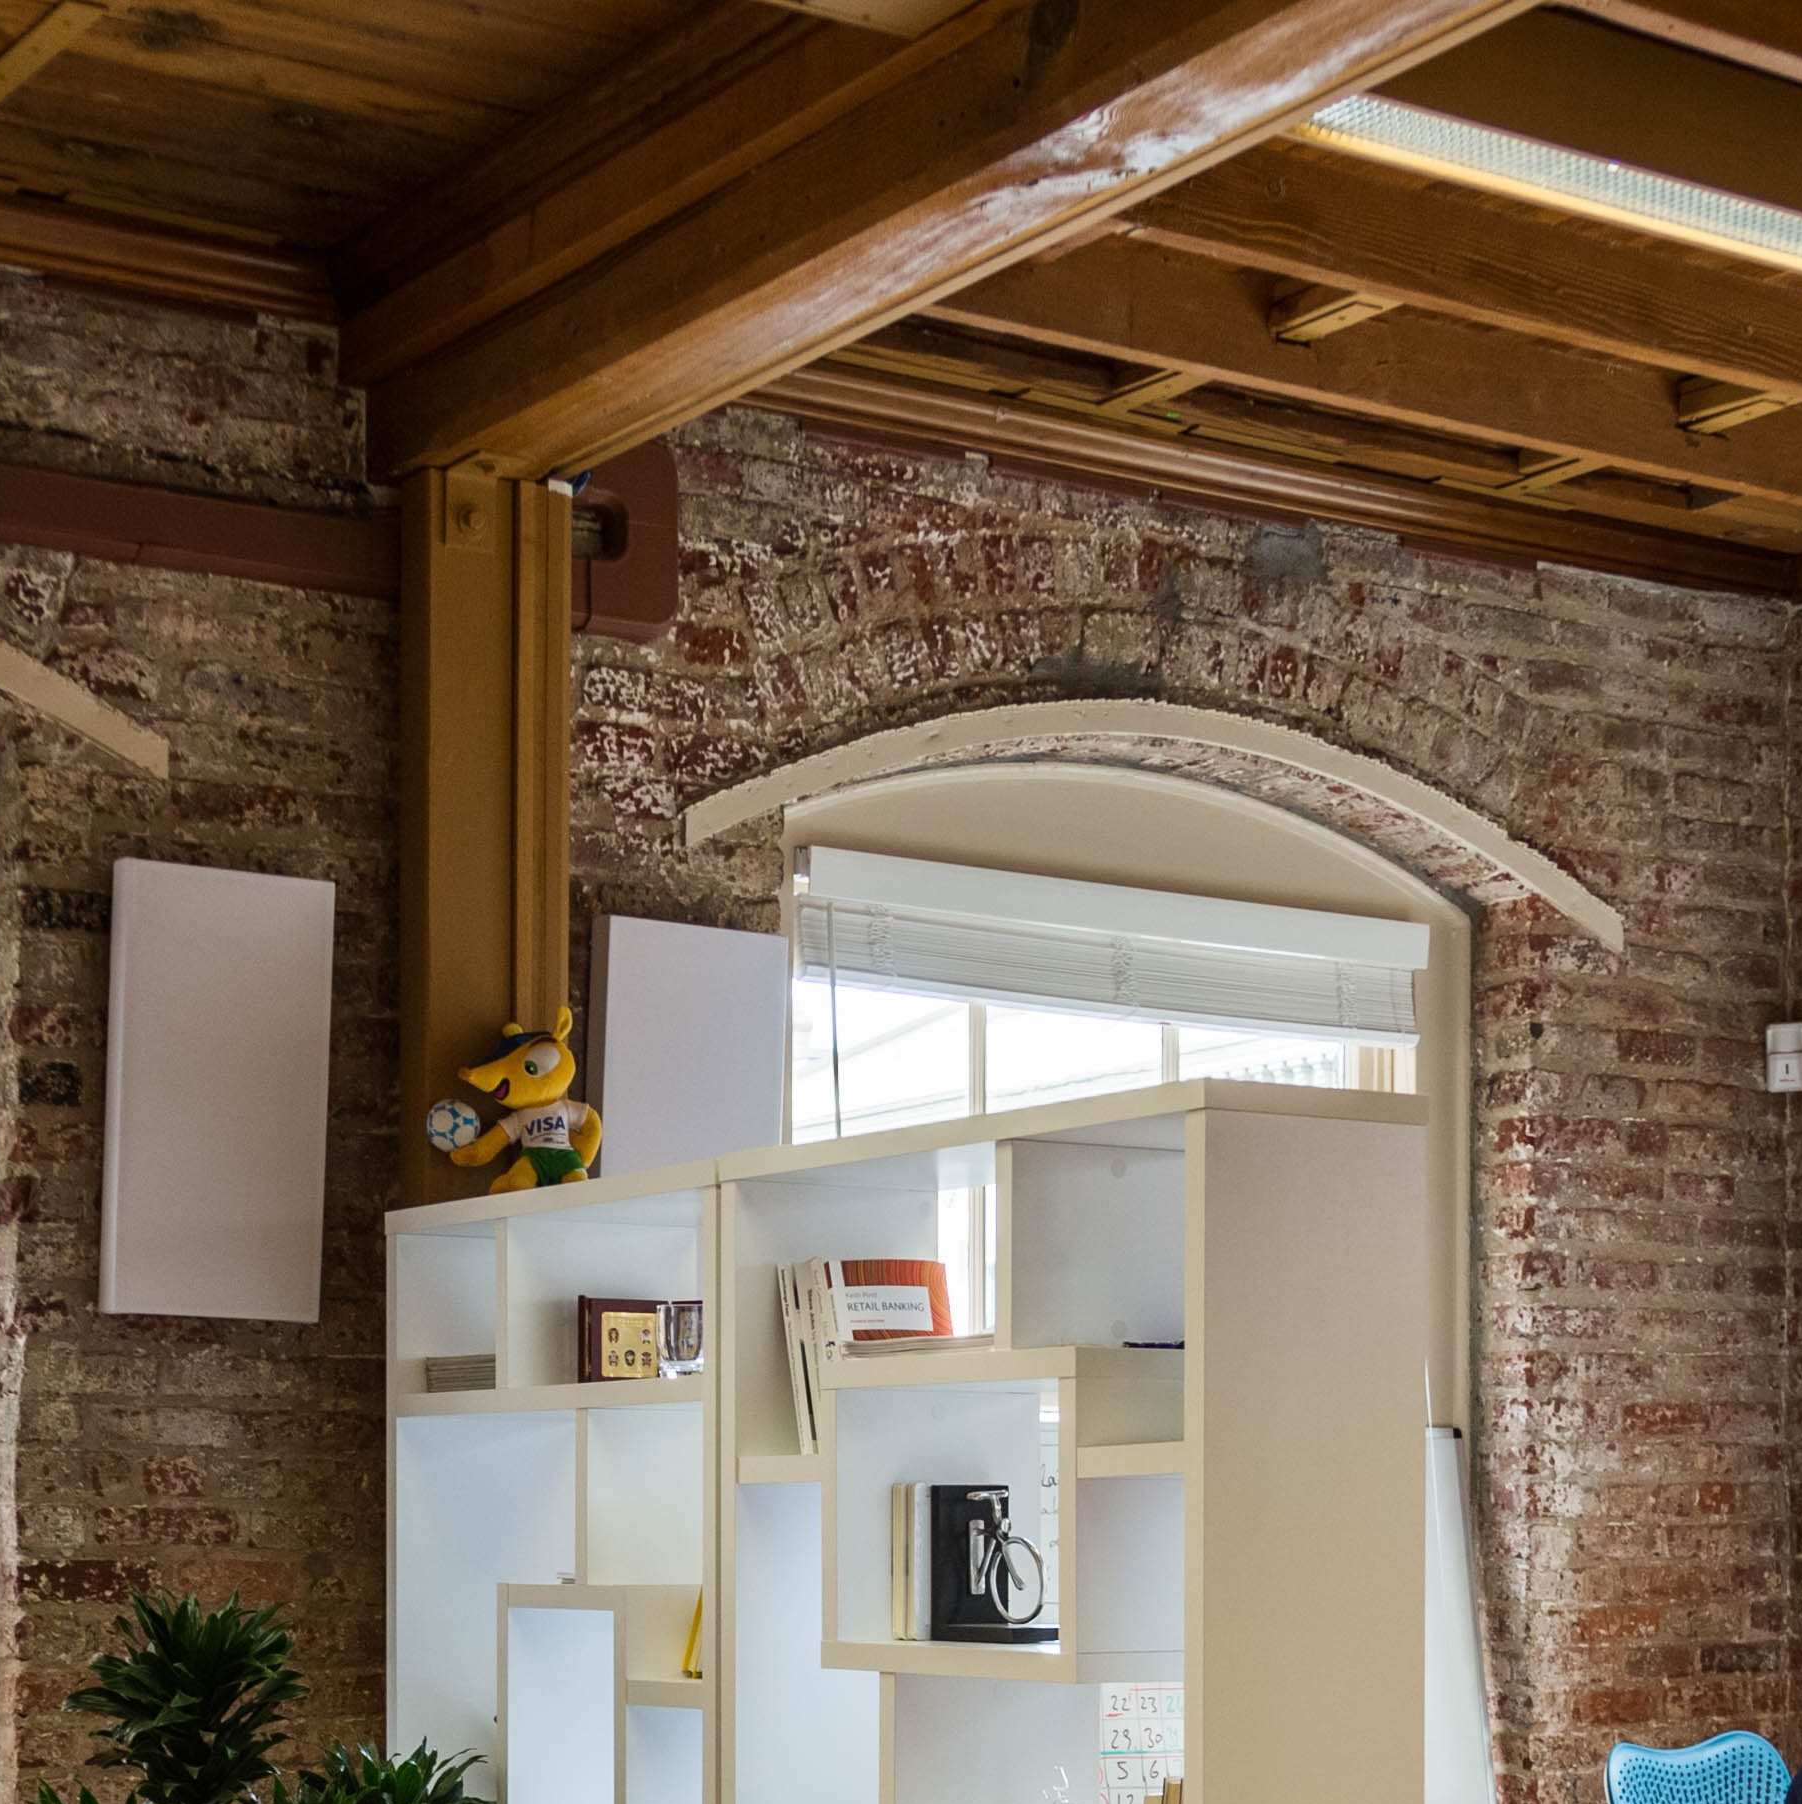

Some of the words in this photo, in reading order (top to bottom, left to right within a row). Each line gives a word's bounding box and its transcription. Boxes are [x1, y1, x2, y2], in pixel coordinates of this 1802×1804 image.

[525, 1116, 566, 1136] VISA
[847, 1302, 880, 1312] RETAIL
[881, 1302, 925, 1312] BANKING
[1110, 1695, 1131, 1711] 22
[1140, 1696, 1157, 1713] 23
[1110, 1729, 1132, 1750] 29
[1144, 1728, 1163, 1749] 30
[1117, 1761, 1129, 1780] 5
[1149, 1760, 1159, 1779] 6
